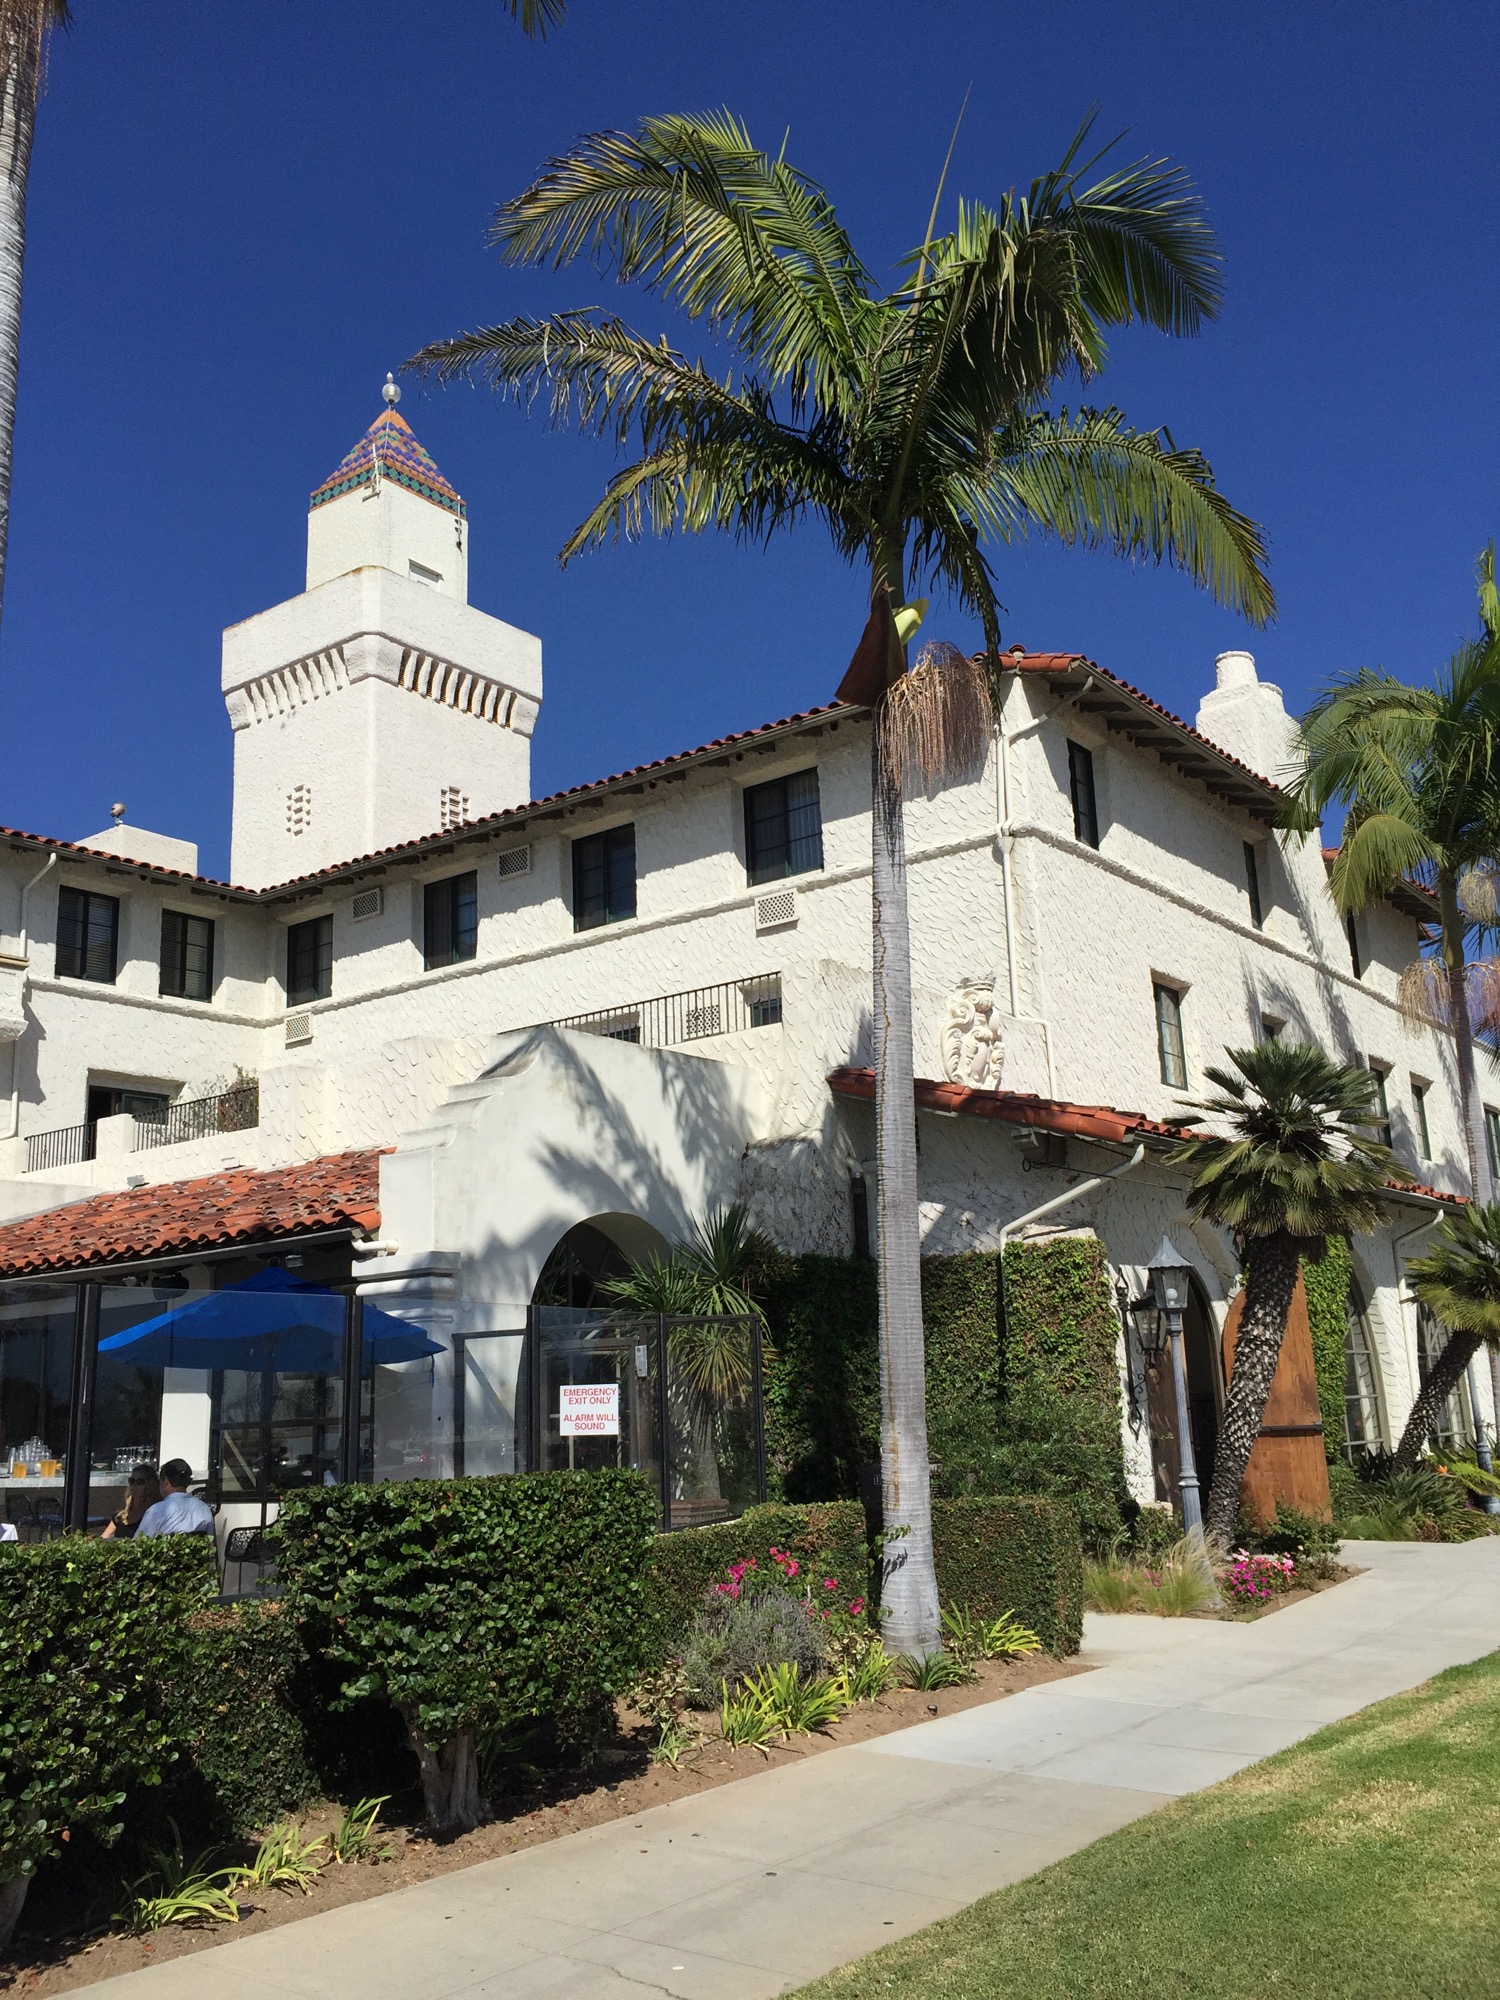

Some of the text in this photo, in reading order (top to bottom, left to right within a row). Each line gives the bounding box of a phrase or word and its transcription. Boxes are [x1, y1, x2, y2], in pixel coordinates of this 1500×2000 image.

[563, 1388, 617, 1396] EMERGENCY
[568, 1396, 611, 1405] EXIT ONLY
[563, 1413, 616, 1422] ALARM WILL
[574, 1422, 605, 1430] SOUND
